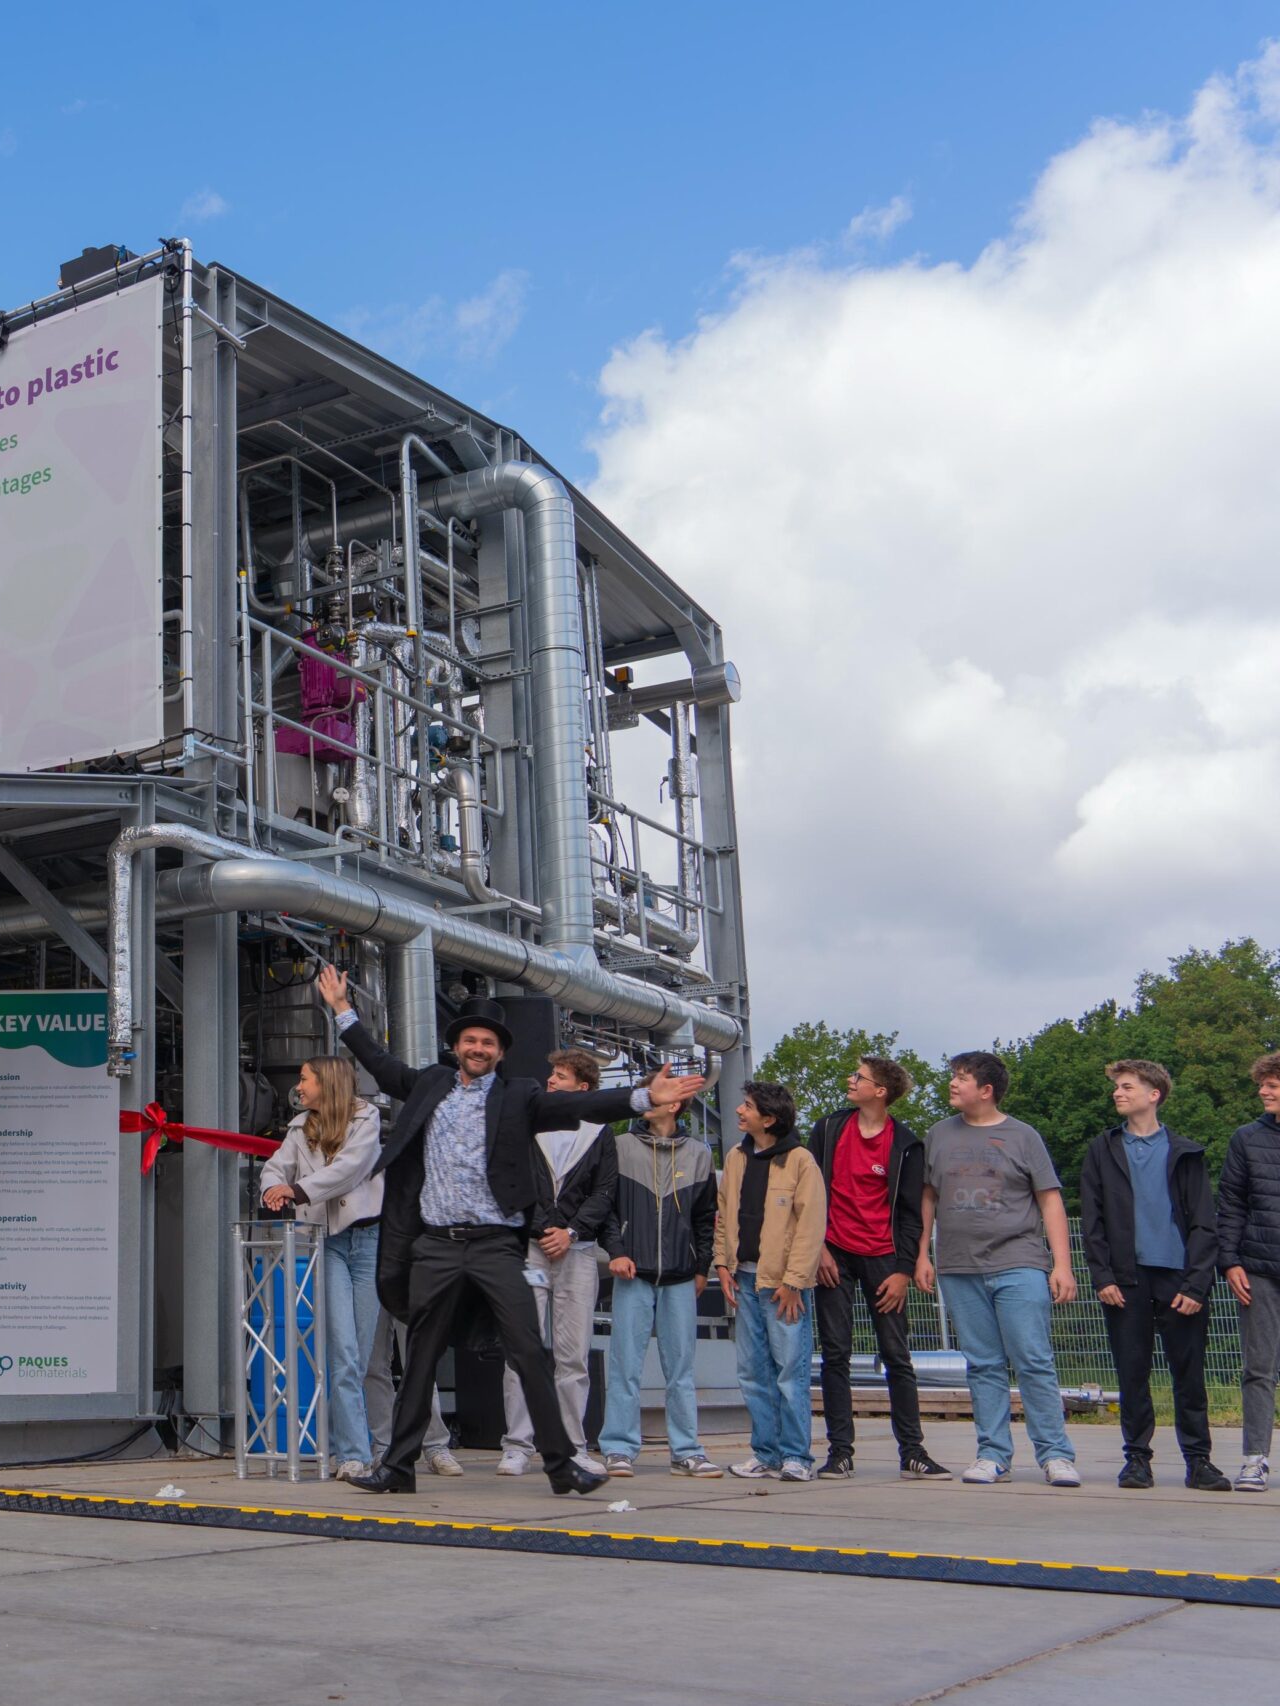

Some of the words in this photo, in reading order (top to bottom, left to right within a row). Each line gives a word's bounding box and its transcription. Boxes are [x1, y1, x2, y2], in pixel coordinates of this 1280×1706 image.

[27, 347, 119, 405] plastic
[36, 1013, 109, 1032] VALUE
[18, 1356, 68, 1368] PAQUES
[19, 1366, 88, 1378] biomaterials
